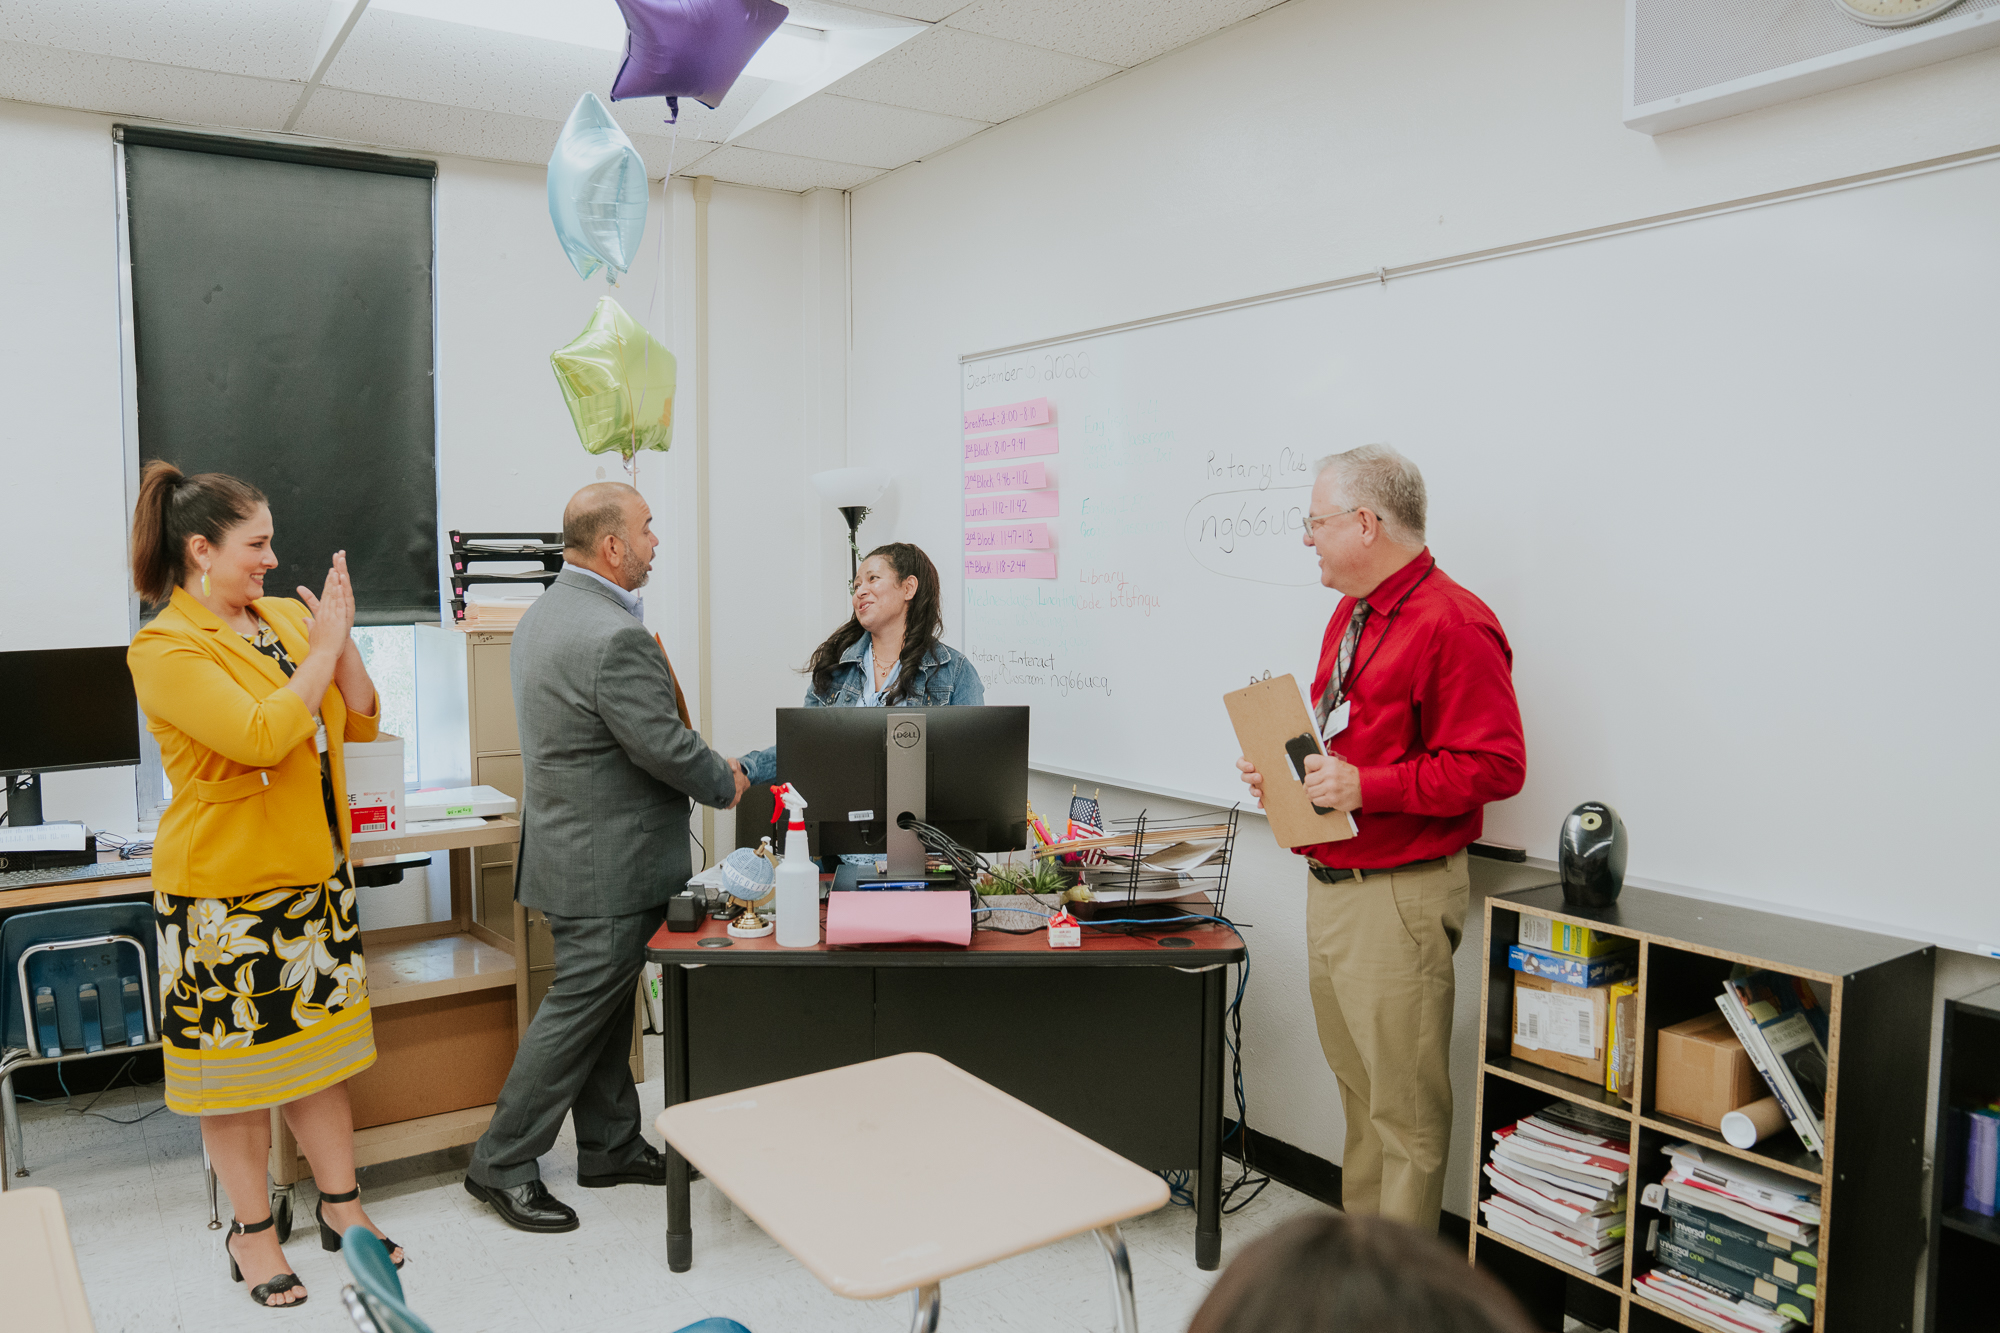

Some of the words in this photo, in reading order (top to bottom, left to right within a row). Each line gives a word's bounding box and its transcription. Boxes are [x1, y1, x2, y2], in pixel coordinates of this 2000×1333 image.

[967, 362, 1023, 390] September
[1025, 355, 1041, 383] 6,
[1044, 351, 1099, 381] 2022
[1206, 449, 1272, 491] Rotary
[1279, 446, 1307, 476] Club
[1199, 501, 1305, 554] ng66uc
[1079, 568, 1129, 591] Library
[967, 586, 1033, 610] Wednesdays
[1076, 591, 1104, 610] Code:
[971, 644, 1005, 675] Rotary
[1008, 650, 1056, 671] Interact
[980, 670, 998, 690] oogle
[1050, 670, 1112, 698] ng66ucq
[896, 731, 918, 739] DELL
[1721, 1003, 1740, 1033] REVISION
[1738, 1032, 1761, 1066] DECISIONS
[1674, 1221, 1706, 1240] universal
[1705, 1233, 1722, 1246] one
[1659, 1239, 1689, 1258] universal
[1689, 1251, 1705, 1264] one
